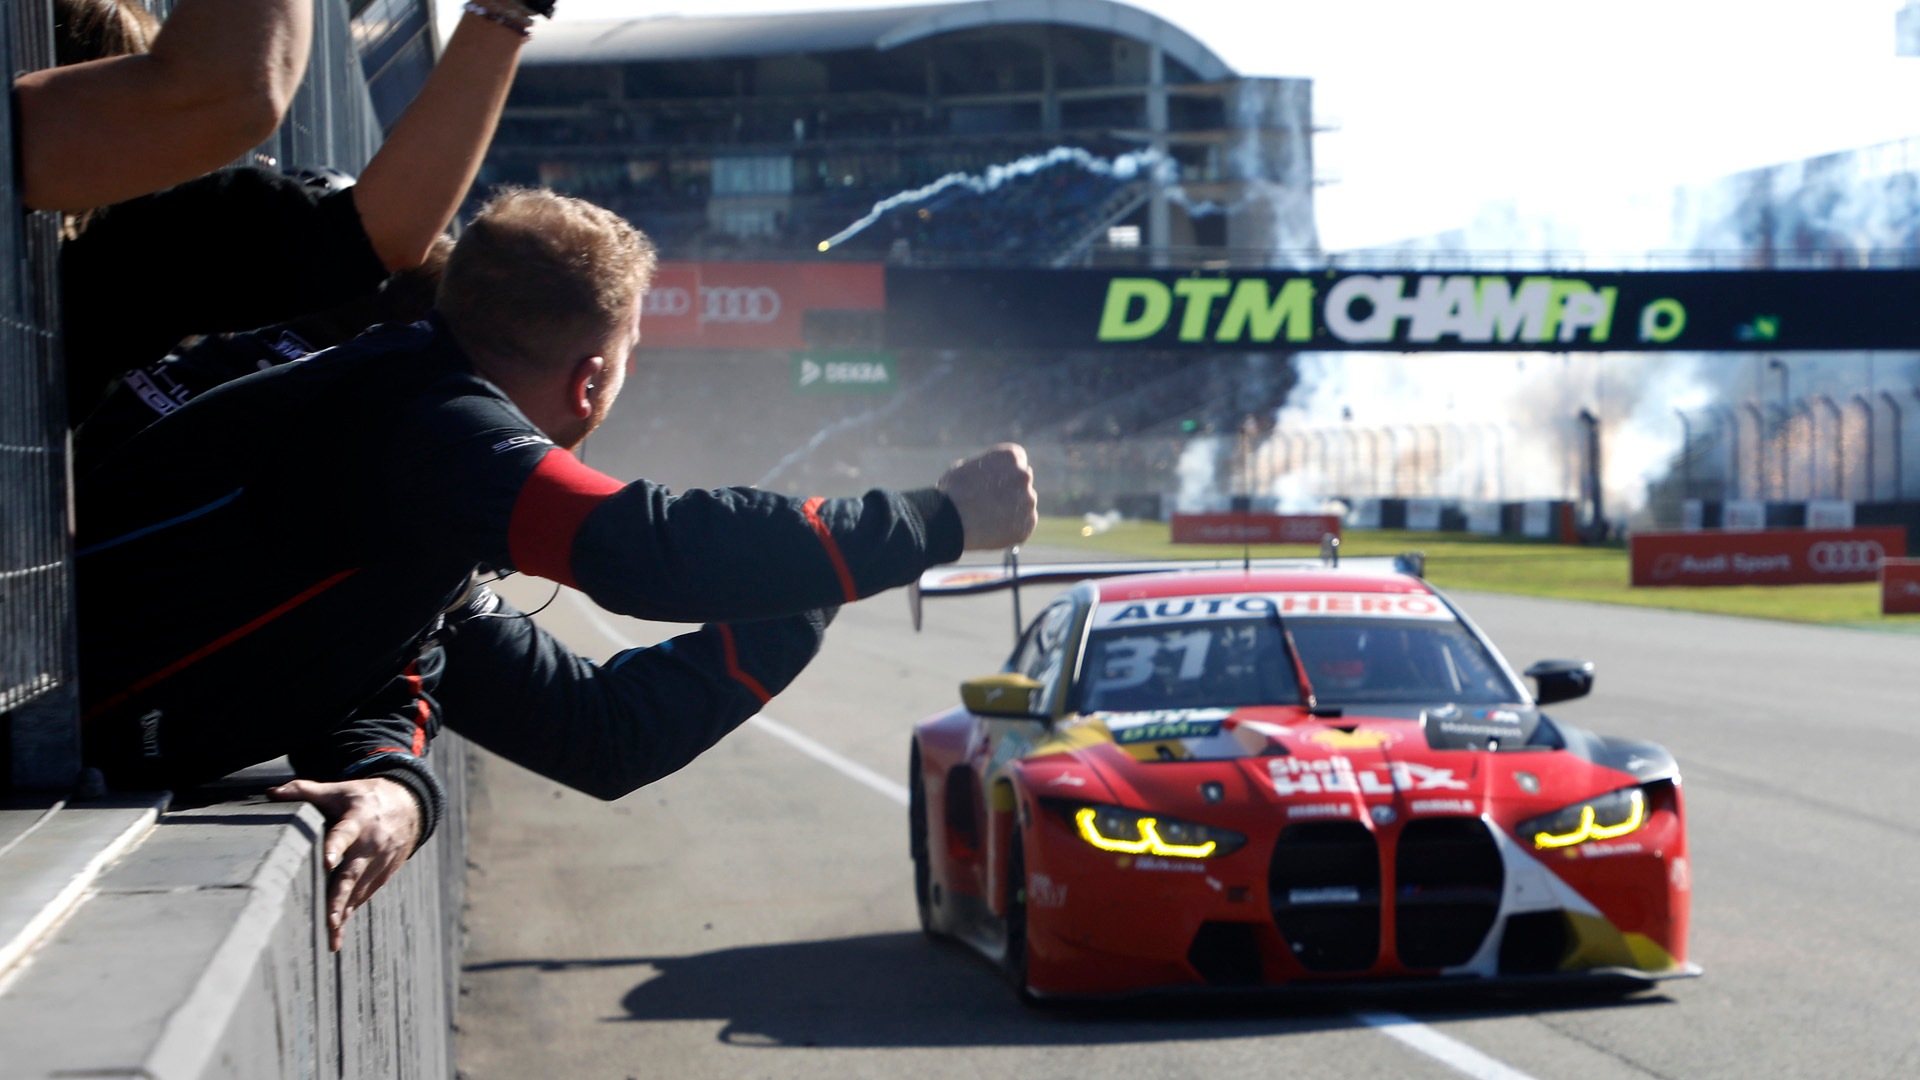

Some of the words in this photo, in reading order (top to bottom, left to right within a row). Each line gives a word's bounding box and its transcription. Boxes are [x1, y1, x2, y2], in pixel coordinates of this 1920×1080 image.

[1097, 277, 1313, 342] DTM
[825, 362, 889, 383] DEKRA
[1681, 553, 1726, 573] Audi
[1732, 552, 1790, 576] Sport
[1111, 597, 1437, 622] AUTOHERO
[1094, 630, 1212, 690] 31
[1267, 755, 1352, 775] Shell
[1273, 762, 1468, 797] HELIX
